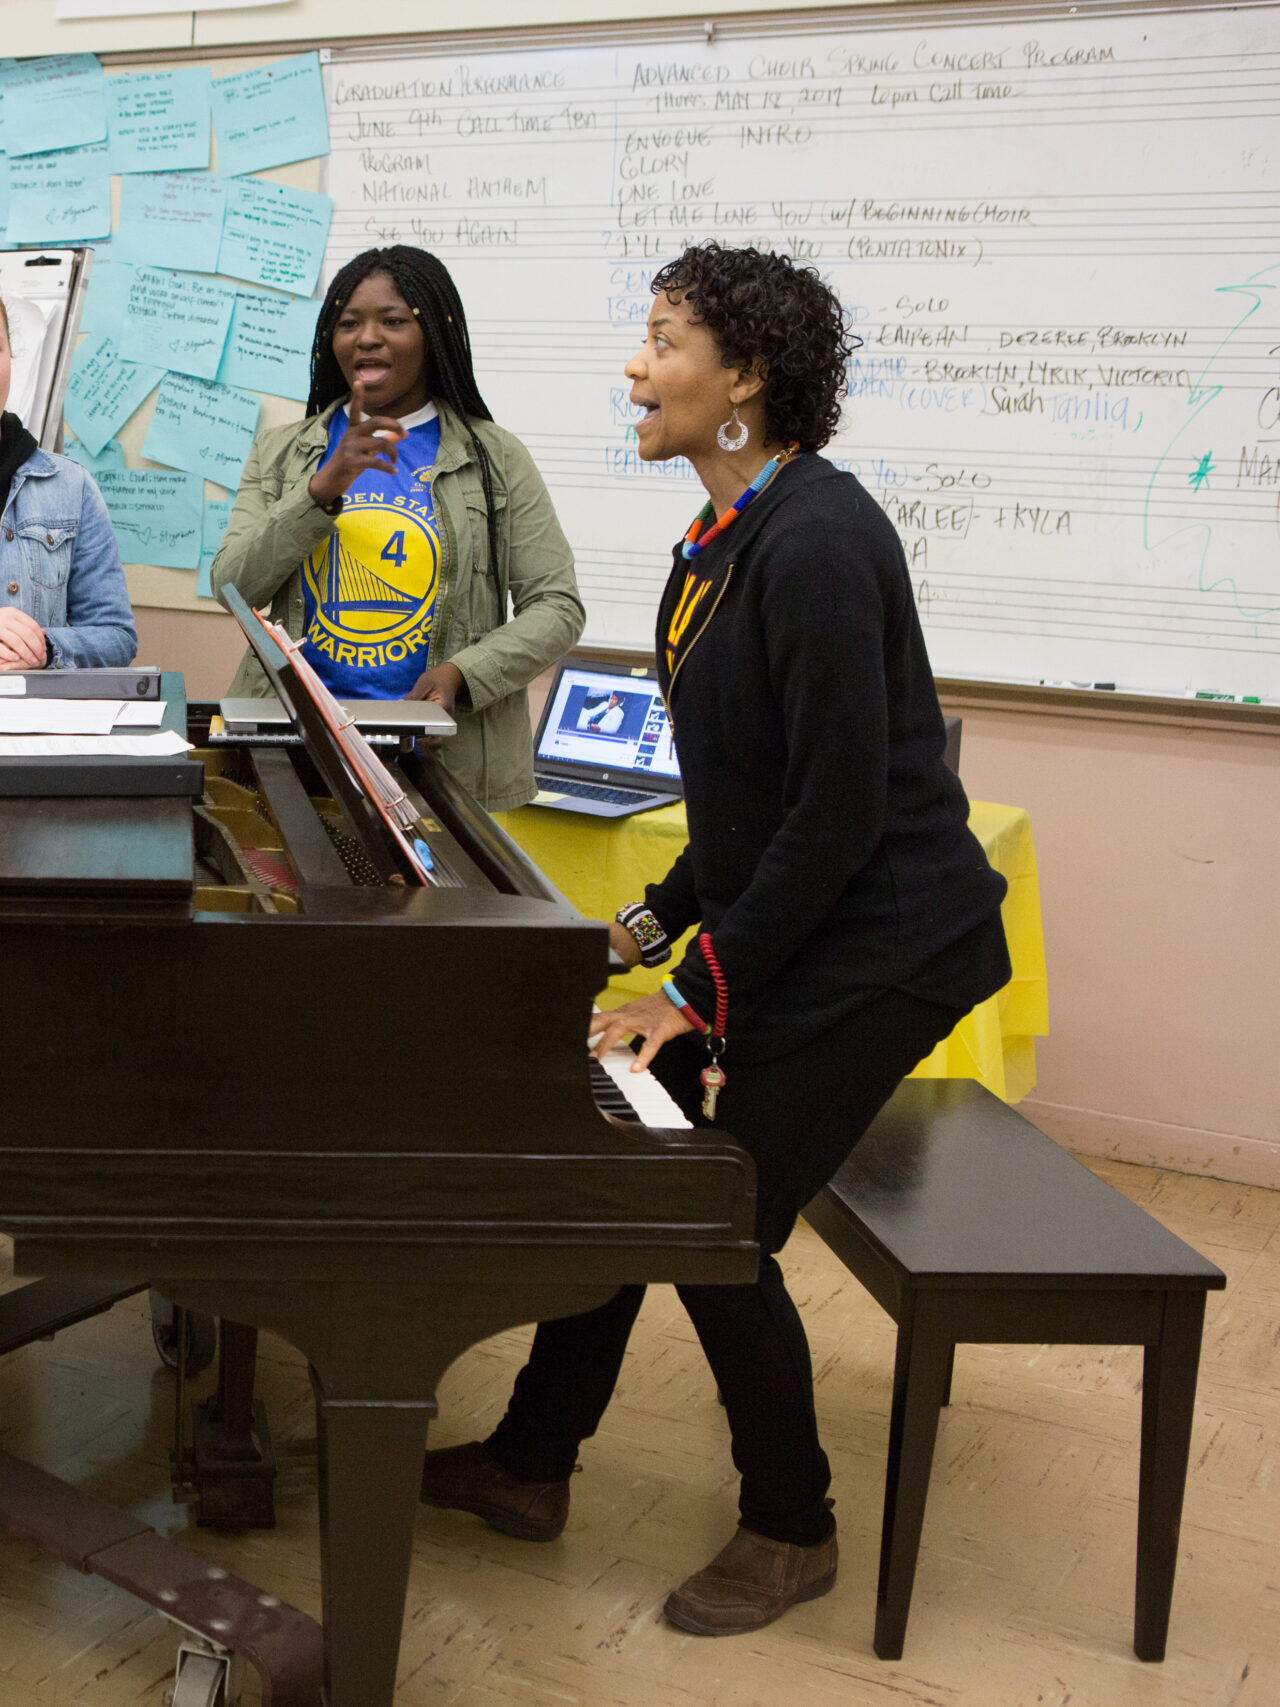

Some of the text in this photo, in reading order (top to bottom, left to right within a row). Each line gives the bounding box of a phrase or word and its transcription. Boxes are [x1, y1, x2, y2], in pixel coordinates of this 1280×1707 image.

[633, 40, 1117, 92] ADVANCED CHOIR SPRING CONCERT PROGRAM
[335, 80, 452, 106] GRADUATION
[714, 90, 750, 111] MAY
[799, 86, 843, 108] 2017
[349, 111, 397, 142] JUNE
[457, 112, 503, 138] CALL
[740, 123, 812, 148] INTRO
[619, 151, 689, 181] GLORY
[362, 175, 547, 205] NATIONAL ANTHEM
[618, 176, 716, 205] ONE LOVE
[410, 217, 444, 244] YOU
[455, 216, 518, 245] AGAIN
[617, 203, 665, 229] LET
[669, 203, 704, 227] ME
[714, 201, 759, 227] LOVE
[771, 201, 813, 230] YOU
[787, 234, 824, 260] YOU
[896, 295, 950, 319] SOLO
[982, 385, 1045, 416] Sarah
[925, 462, 992, 492] SOLO
[342, 492, 439, 532] DEN STAT
[380, 530, 408, 568] 4
[308, 614, 435, 668] WARRIORS
